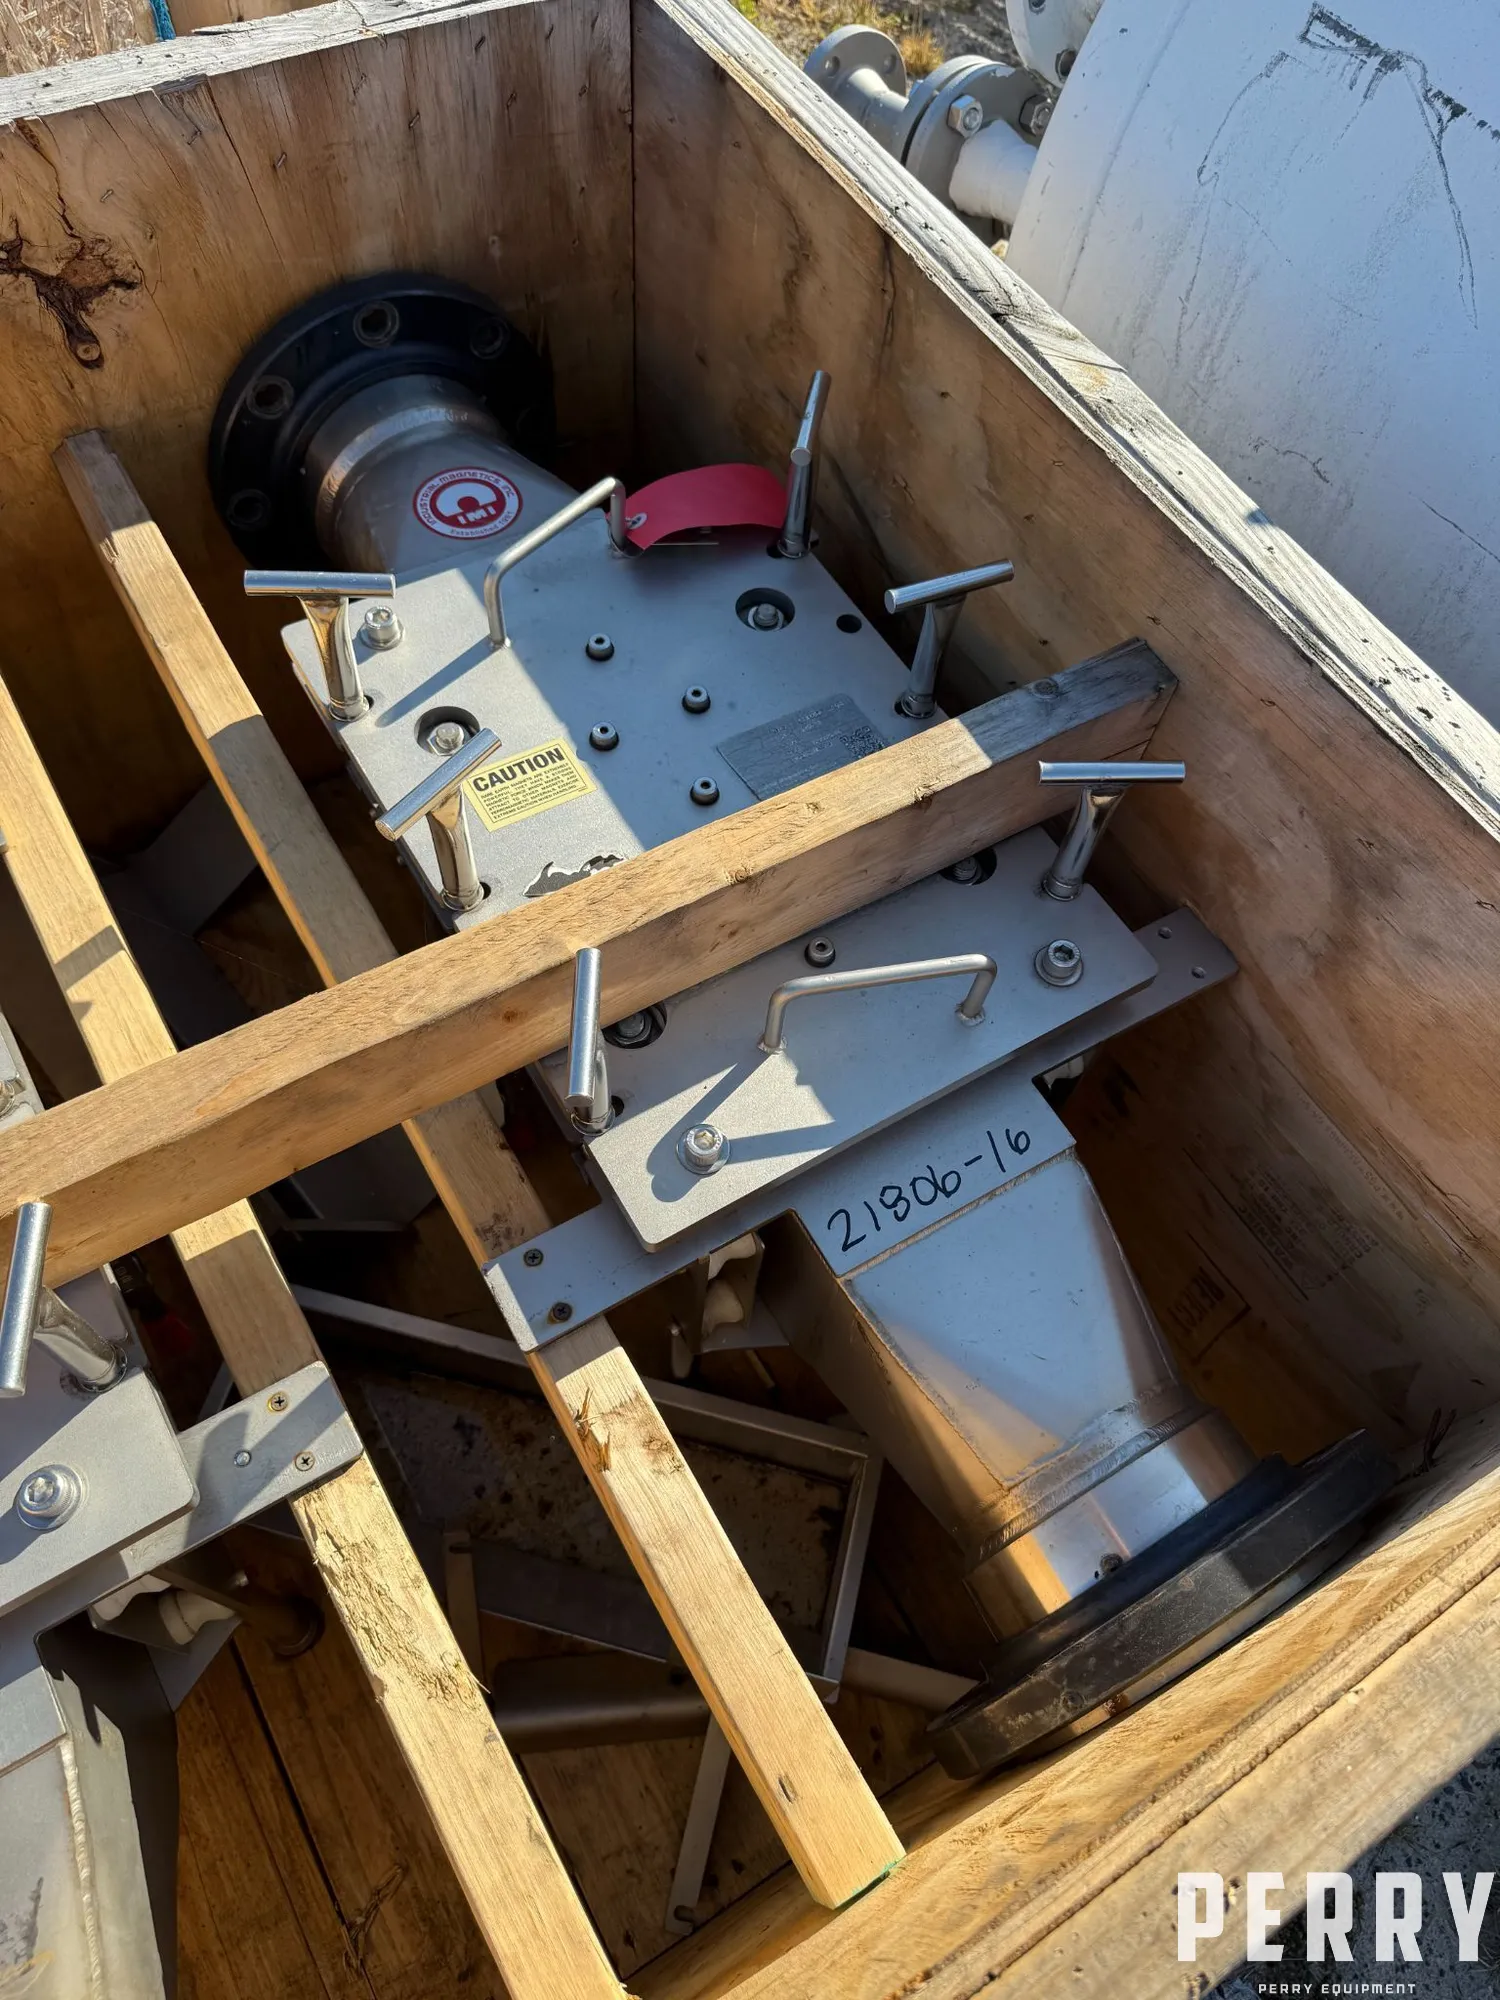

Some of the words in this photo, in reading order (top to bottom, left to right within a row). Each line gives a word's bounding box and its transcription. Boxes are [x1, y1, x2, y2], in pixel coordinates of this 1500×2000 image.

[457, 505, 497, 525] IMI
[473, 747, 565, 792] CAUTION
[480, 791, 493, 799] RARE
[494, 785, 510, 793] EARTH
[510, 776, 532, 787] MAGNETS
[543, 762, 569, 774] EXTREMELY
[551, 766, 571, 776] STRONG
[485, 795, 509, 807] MAGNETIC
[510, 789, 526, 797] FORCE
[527, 782, 543, 790] WHICH
[543, 775, 560, 784] MAKES
[488, 800, 510, 811] ATTRACT
[521, 789, 539, 798] OTHER
[540, 779, 564, 790] MAGNETS
[490, 798, 529, 815] FERROMAGNETIC
[557, 778, 579, 789] EXERCISE
[493, 808, 516, 819] EXTREME
[516, 799, 538, 810] CAUTION
[537, 793, 553, 801] WHEN
[827, 1128, 1031, 1252] 21806-16
